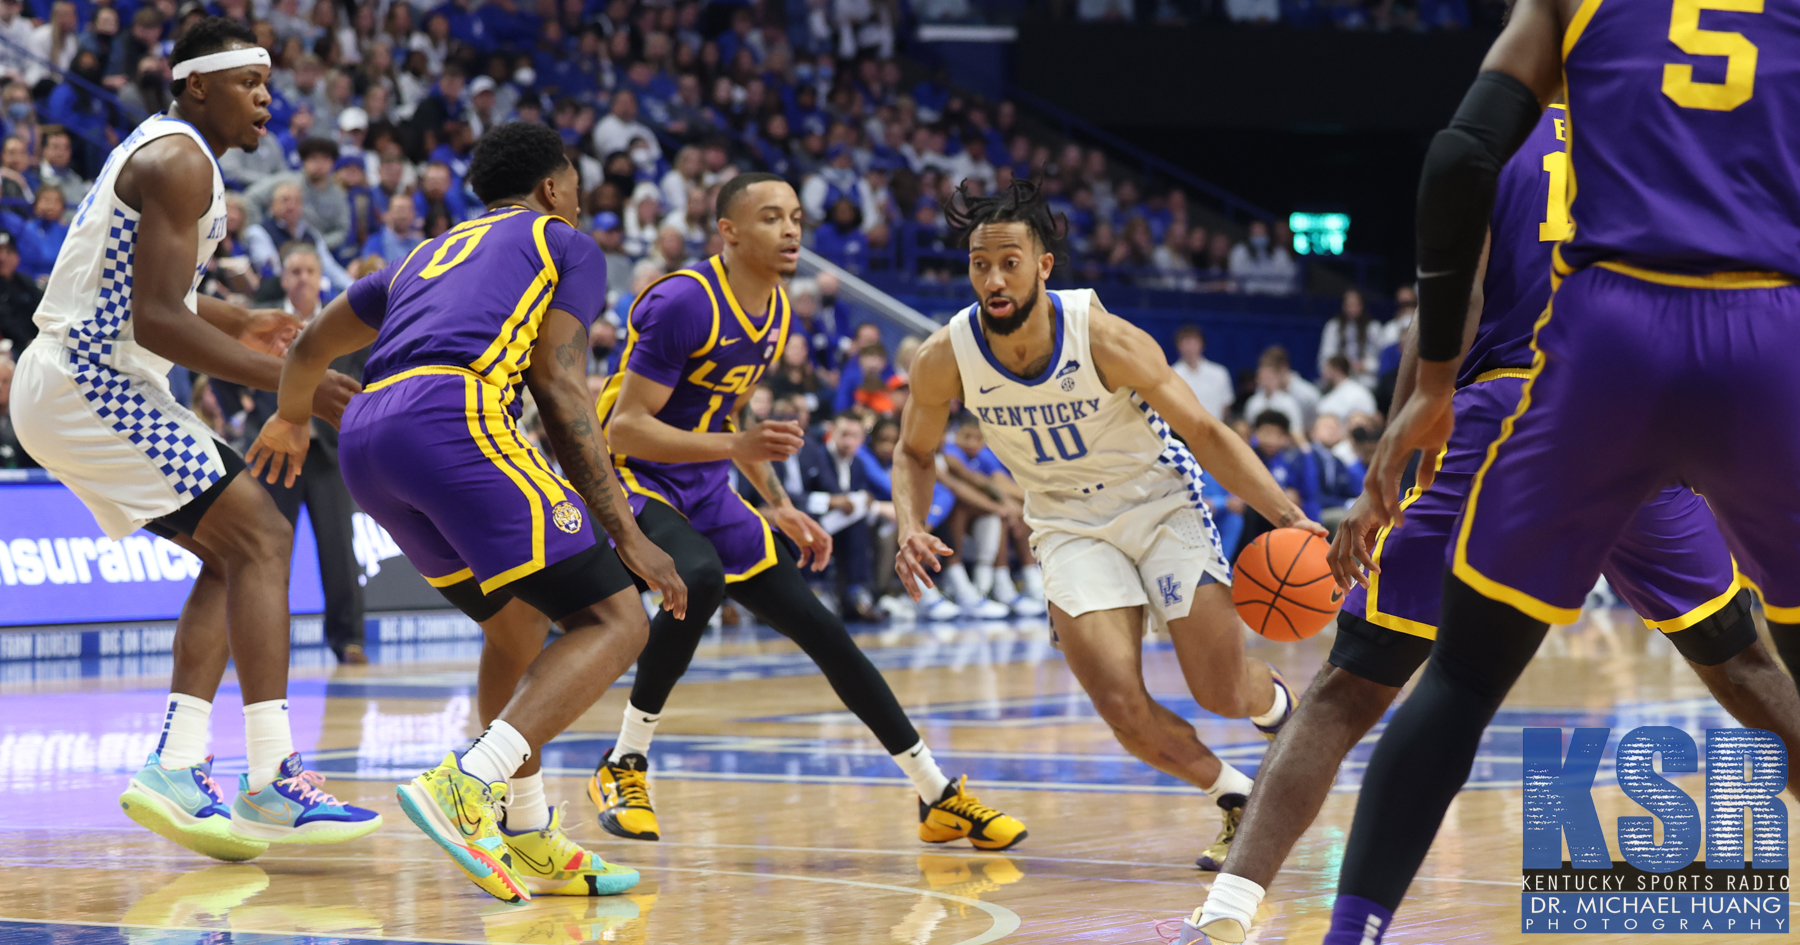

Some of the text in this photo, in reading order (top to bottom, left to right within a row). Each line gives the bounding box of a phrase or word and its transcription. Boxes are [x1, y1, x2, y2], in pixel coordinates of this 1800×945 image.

[1661, 0, 1765, 112] 5
[1539, 151, 1577, 242] 1
[418, 224, 493, 280] 0
[687, 359, 766, 395] LSU
[692, 394, 724, 433] 1
[977, 398, 1101, 427] KENTUCKY
[1022, 423, 1088, 464] 10
[0, 632, 33, 660] FARM
[35, 630, 82, 659] BUREAU
